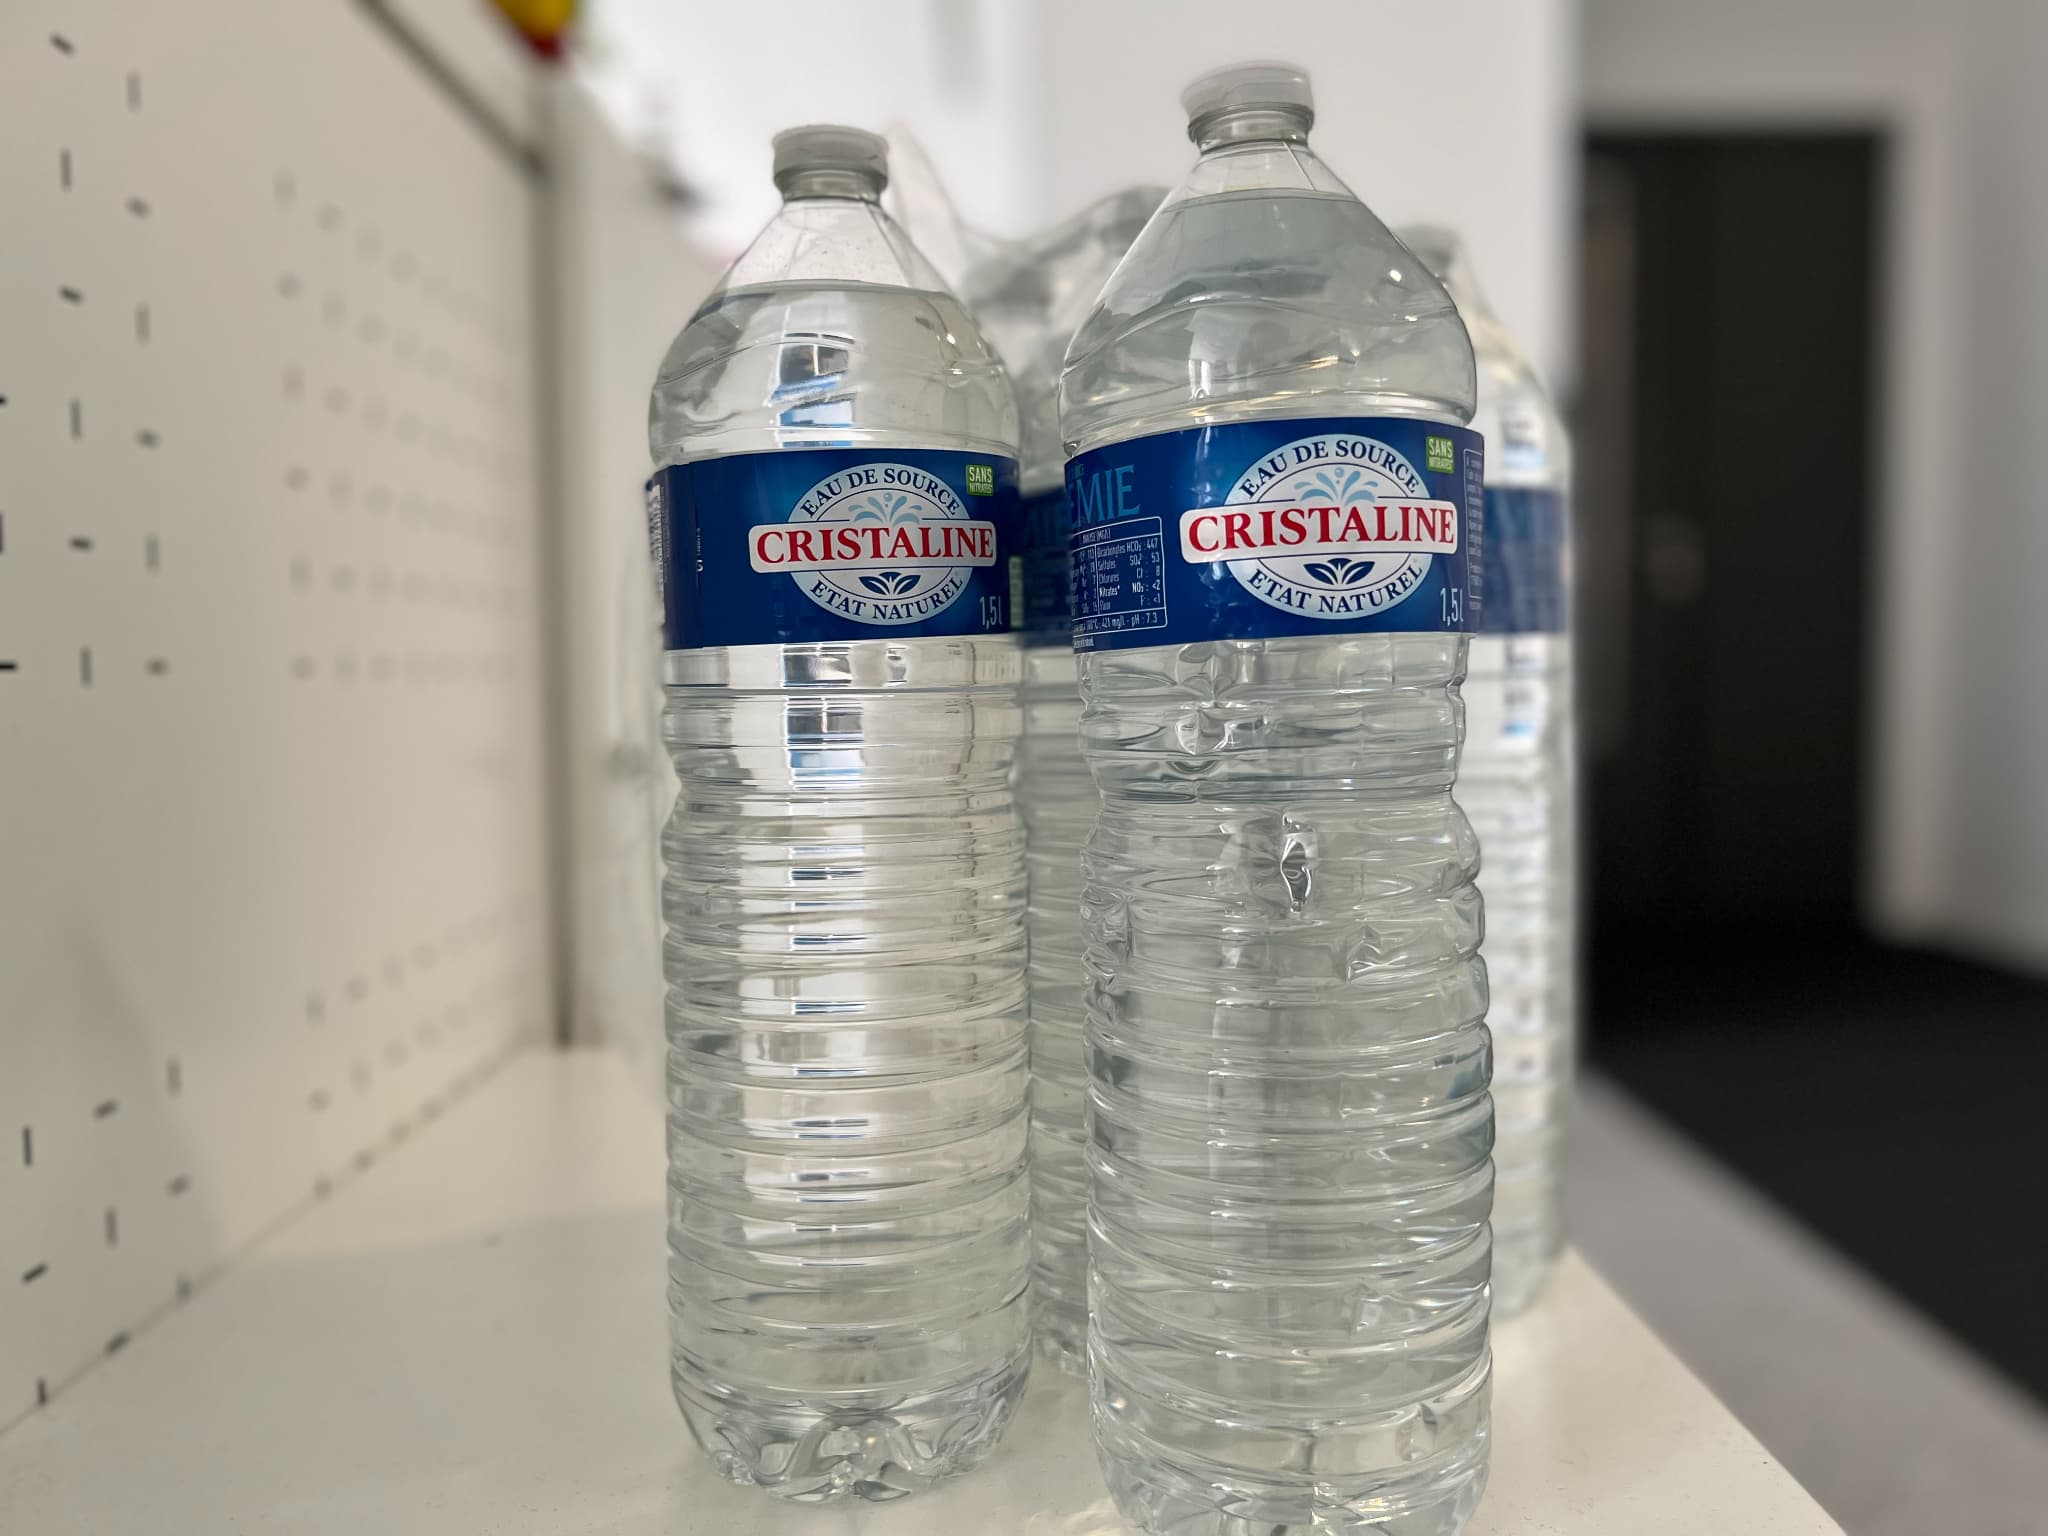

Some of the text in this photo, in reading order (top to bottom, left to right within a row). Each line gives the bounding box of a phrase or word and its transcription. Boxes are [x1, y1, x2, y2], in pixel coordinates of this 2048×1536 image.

[1239, 439, 1420, 499] EAU DE SOURCE
[1429, 438, 1453, 458] SANS
[800, 468, 961, 519] EAU DE SOURCE
[968, 466, 993, 483] SANS
[756, 526, 994, 564] CRISTALINE
[1188, 506, 1455, 552] CRISTALINE
[810, 580, 866, 617] ETAT
[872, 576, 965, 620] NATUREL
[1247, 565, 1423, 613] ETAT NATUREL
